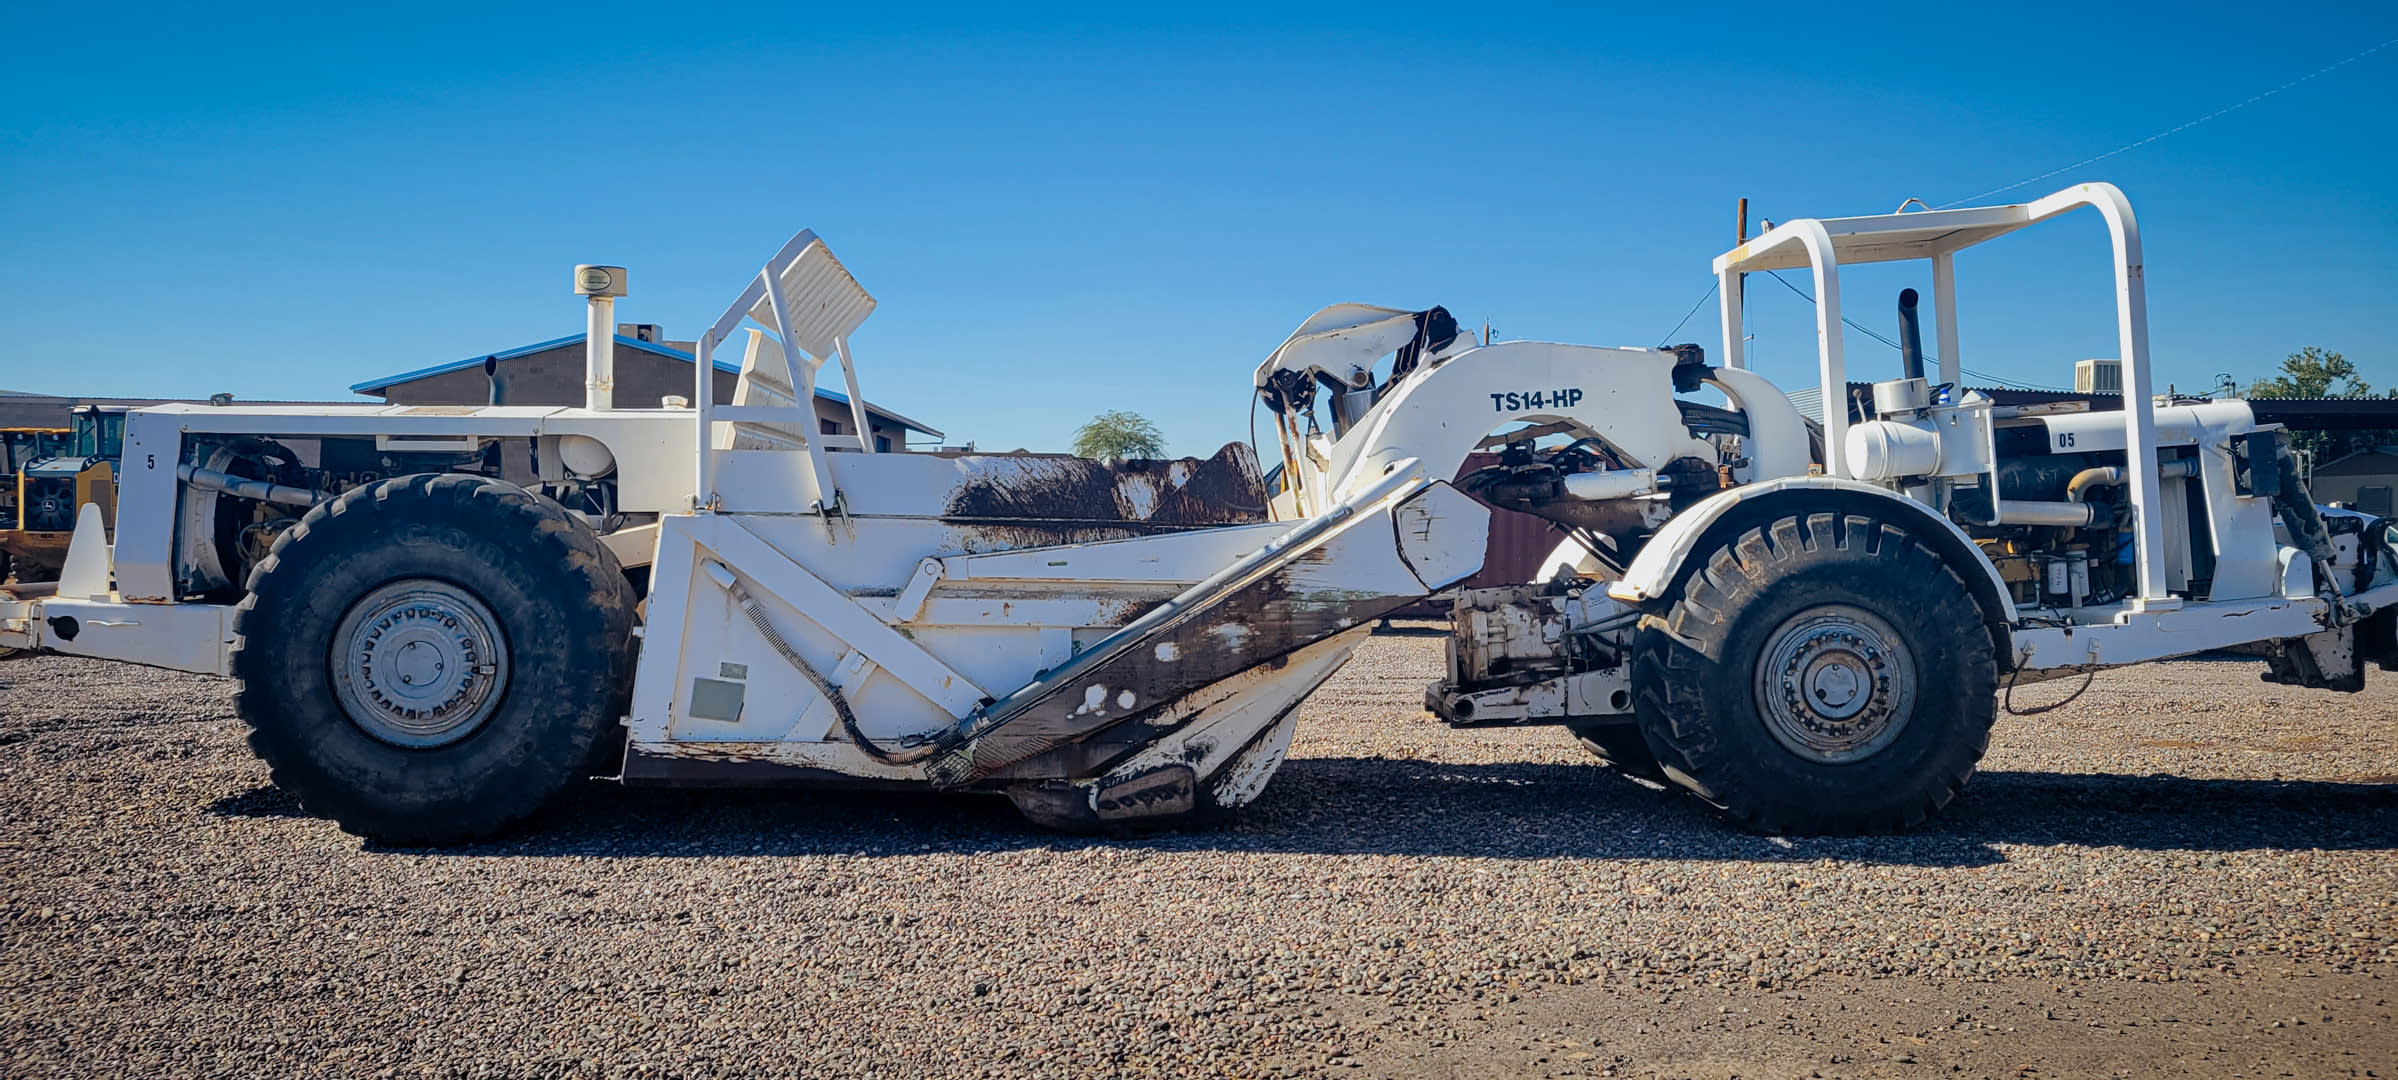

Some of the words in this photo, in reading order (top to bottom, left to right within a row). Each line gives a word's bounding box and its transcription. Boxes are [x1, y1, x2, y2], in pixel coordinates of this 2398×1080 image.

[1490, 388, 1583, 412] TS14-HP
[2059, 432, 2075, 448] 05
[147, 454, 155, 470] 5
